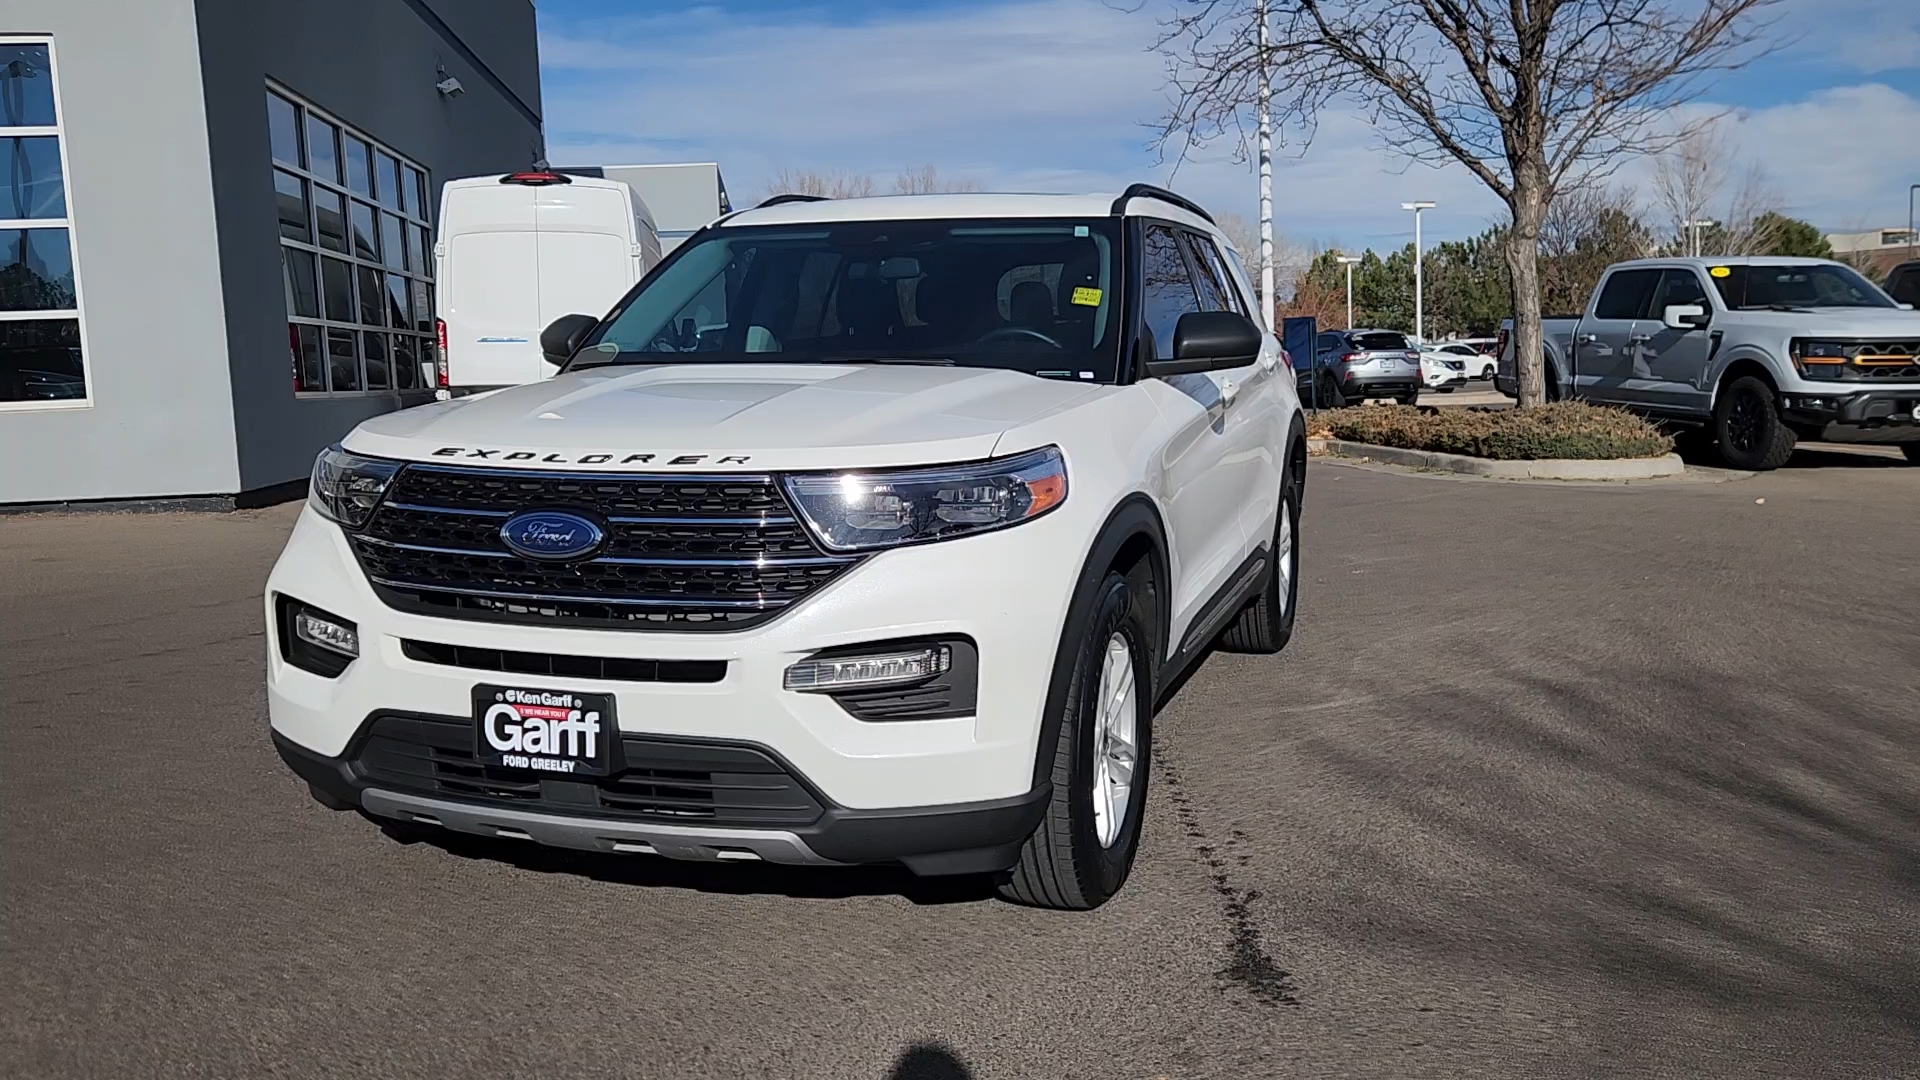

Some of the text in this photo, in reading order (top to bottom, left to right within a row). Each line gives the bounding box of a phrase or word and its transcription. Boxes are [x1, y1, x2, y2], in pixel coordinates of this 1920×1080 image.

[431, 447, 752, 466] EXPLORER
[521, 521, 577, 544] Ford
[516, 690, 573, 708] Ken Garff
[525, 708, 562, 718] WE HEAR YOU
[484, 703, 600, 759] Garff
[502, 754, 575, 773] FORD GREELEY
